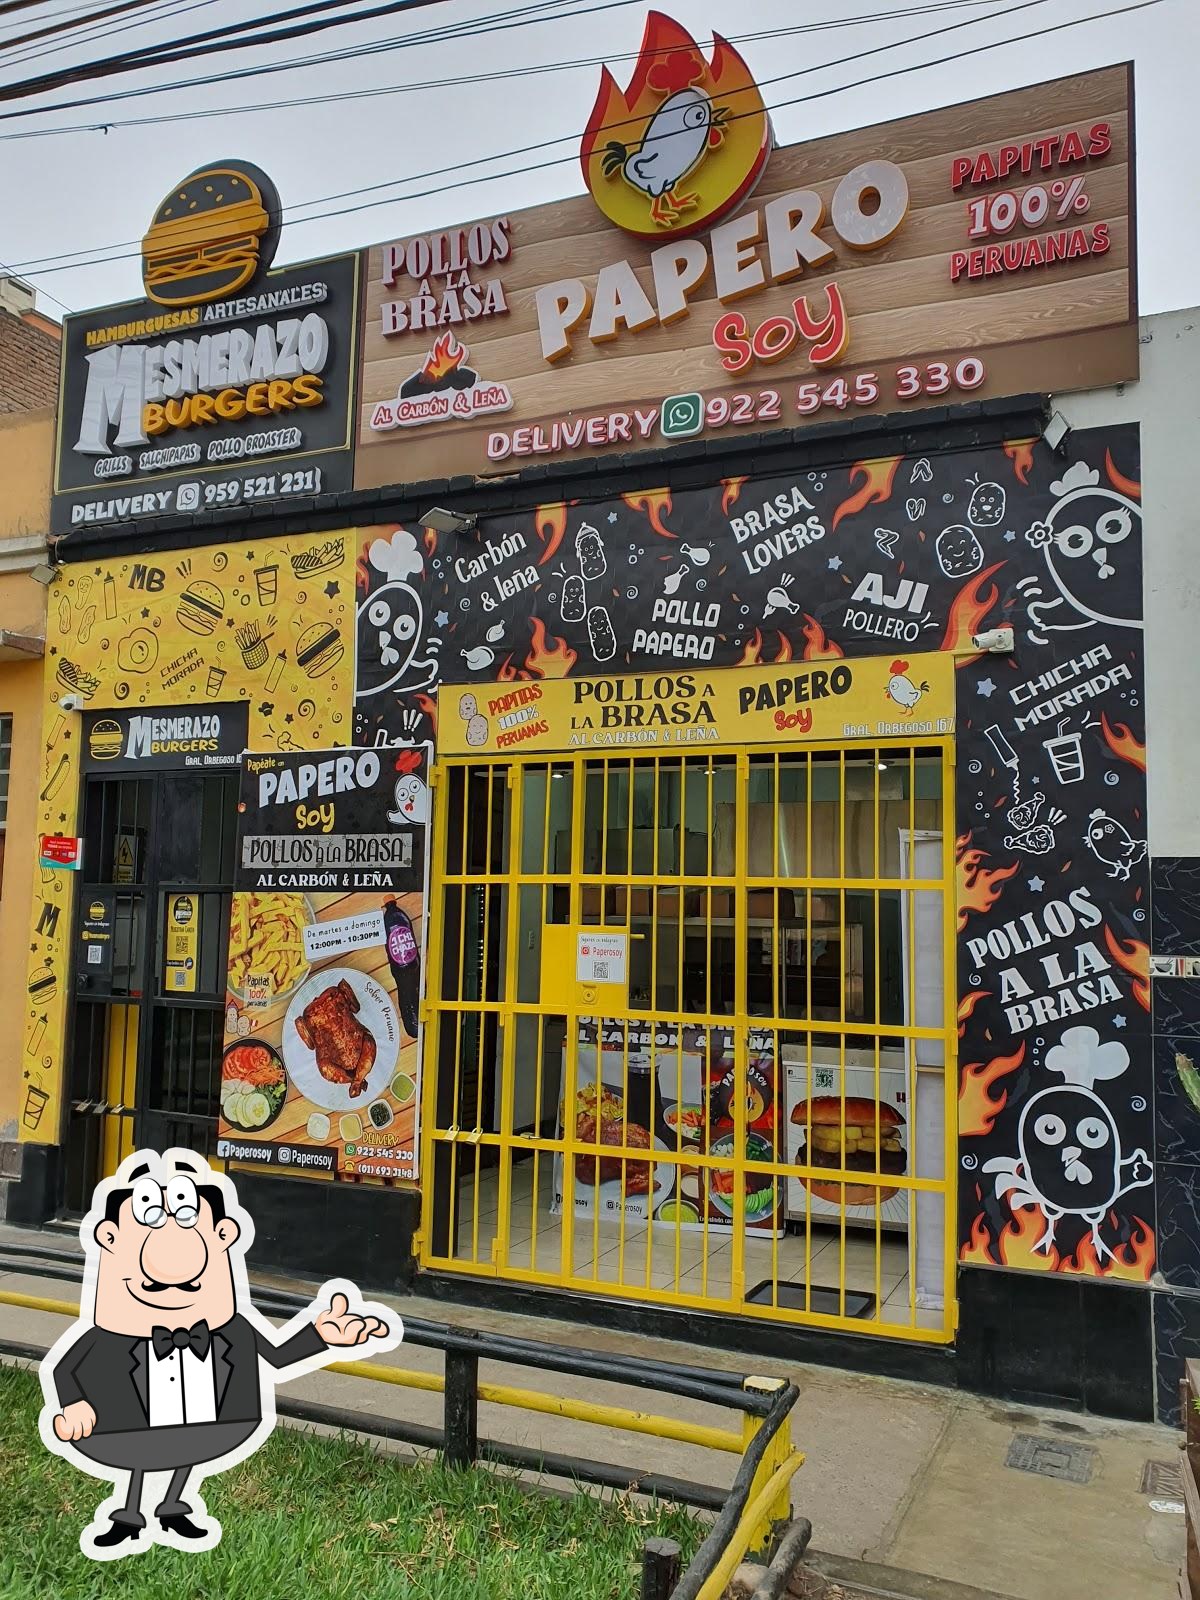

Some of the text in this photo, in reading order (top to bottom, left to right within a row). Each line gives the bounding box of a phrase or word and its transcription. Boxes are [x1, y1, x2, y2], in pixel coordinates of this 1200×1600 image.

[951, 123, 1111, 190] PAPITAS
[967, 176, 1090, 238] 100%
[381, 217, 510, 285] POLLOS
[535, 159, 909, 363] PAPERO
[949, 224, 1110, 283] PERUANAS
[418, 270, 470, 295] A LA
[86, 282, 327, 345] HAMBURGUESAS ARTESANALES
[380, 279, 507, 335] BRASA
[72, 312, 328, 454] MESMERAZO
[143, 375, 324, 435] BURGERS
[453, 392, 470, 413] &
[487, 357, 985, 460] DELIVERY 922 545 330
[95, 428, 298, 476] GRILLS SALCHIPAPAS POLLO BROASTER
[71, 470, 315, 524] DELIVERY 959 521 231
[729, 487, 815, 545] BRASA
[455, 532, 527, 583] Carbón
[740, 516, 827, 576] LOVERS
[128, 563, 166, 593] MB
[481, 565, 540, 612] & leña
[851, 572, 929, 613] AJI
[652, 598, 721, 627] POLLO
[843, 609, 920, 642] POLLERO
[632, 630, 717, 660] PAPERO
[160, 648, 199, 678] CHICHA
[162, 657, 206, 691] MORADA
[1009, 643, 1114, 707] CHICHA
[487, 683, 543, 716] PAPITAS
[573, 675, 715, 704] POLLOS A
[739, 665, 852, 714] PAPERO
[1014, 663, 1133, 733] MORADA
[498, 704, 539, 730] 100%
[571, 700, 717, 730] LA BRASA
[935, 717, 955, 733] 167
[124, 714, 221, 760] MESMERAZO
[151, 739, 219, 755] BURGERS
[496, 720, 549, 749] PERUANAS
[568, 732, 591, 747] AL
[592, 728, 658, 745] CARBÓN
[675, 725, 720, 742] LEÑA
[247, 757, 276, 775] Papéate
[259, 751, 381, 808] PAPERO
[250, 837, 403, 864] POLLOS A LA BRASA
[256, 871, 394, 887] AL CARBÓN & LEÑA
[34, 902, 61, 938] M
[307, 930, 316, 938] De
[318, 927, 342, 937] martes
[351, 919, 381, 930] domingo
[966, 886, 1103, 970] POLLOS
[310, 939, 342, 950] 12:00PM
[348, 931, 380, 942] 10:30PM
[592, 946, 623, 959] Paperosoy
[247, 974, 270, 989] Papitas
[999, 940, 1112, 1005] A LA
[249, 988, 267, 999] 100%
[1003, 975, 1123, 1034] BRASA
[723, 1035, 776, 1050] LÑA
[356, 1146, 413, 1161] 922 545 330
[362, 1131, 399, 1146] DELIVERY
[230, 1145, 333, 1170] Paperosoy Paperosoy
[358, 1164, 413, 1178] (01) 693 3148
[615, 1202, 643, 1214] Paerosoy
